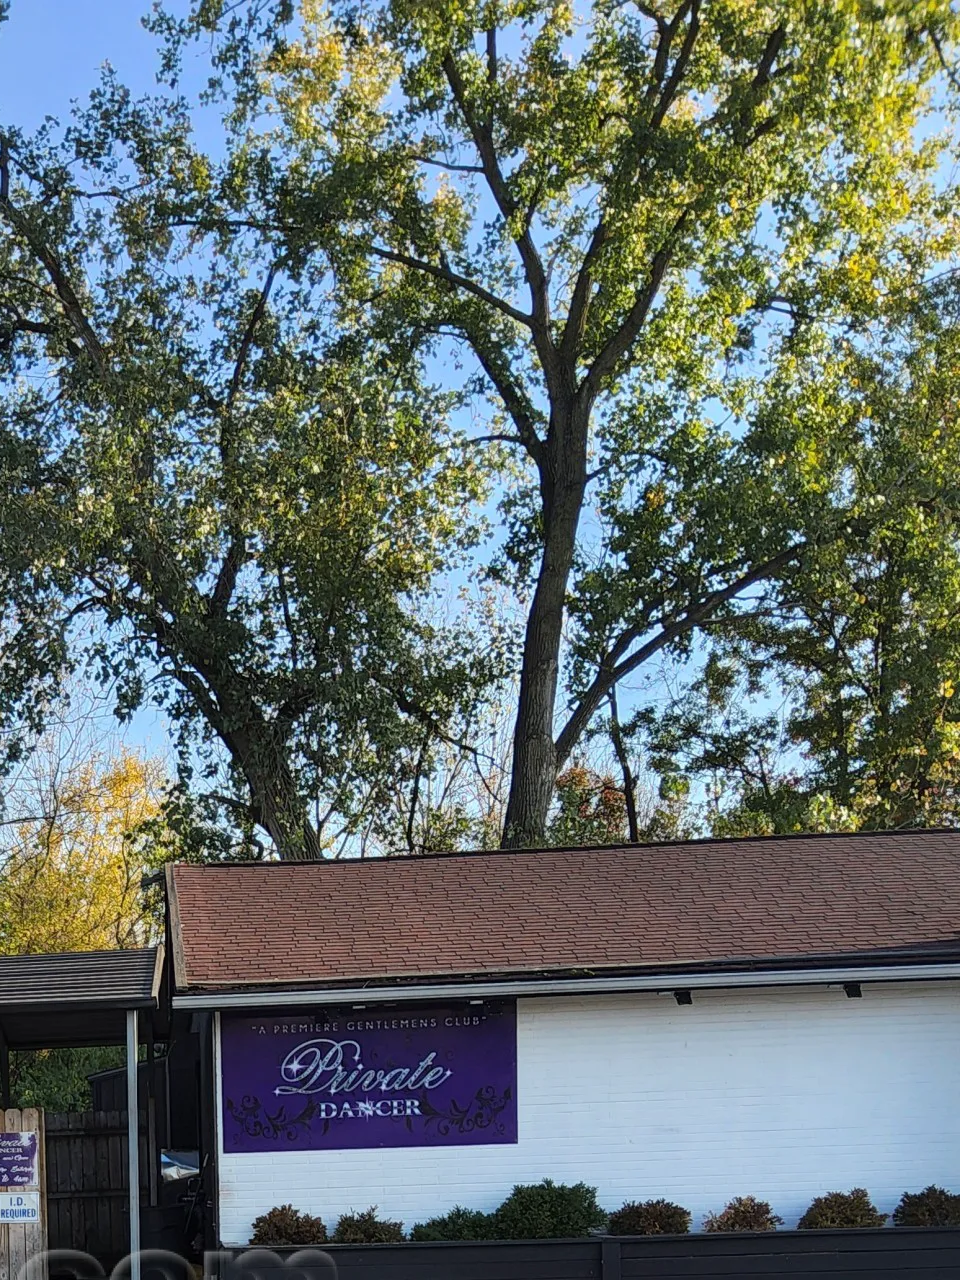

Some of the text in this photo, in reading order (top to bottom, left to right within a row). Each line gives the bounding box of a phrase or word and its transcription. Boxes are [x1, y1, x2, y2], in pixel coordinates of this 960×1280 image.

[274, 1022, 339, 1034] PREMIERE
[347, 1018, 437, 1031] GENTLEMENS
[273, 1038, 451, 1095] Private
[319, 1099, 423, 1119] DANCER
[9, 1196, 27, 1206] I.D.
[0, 1208, 37, 1219] REQUIRED
